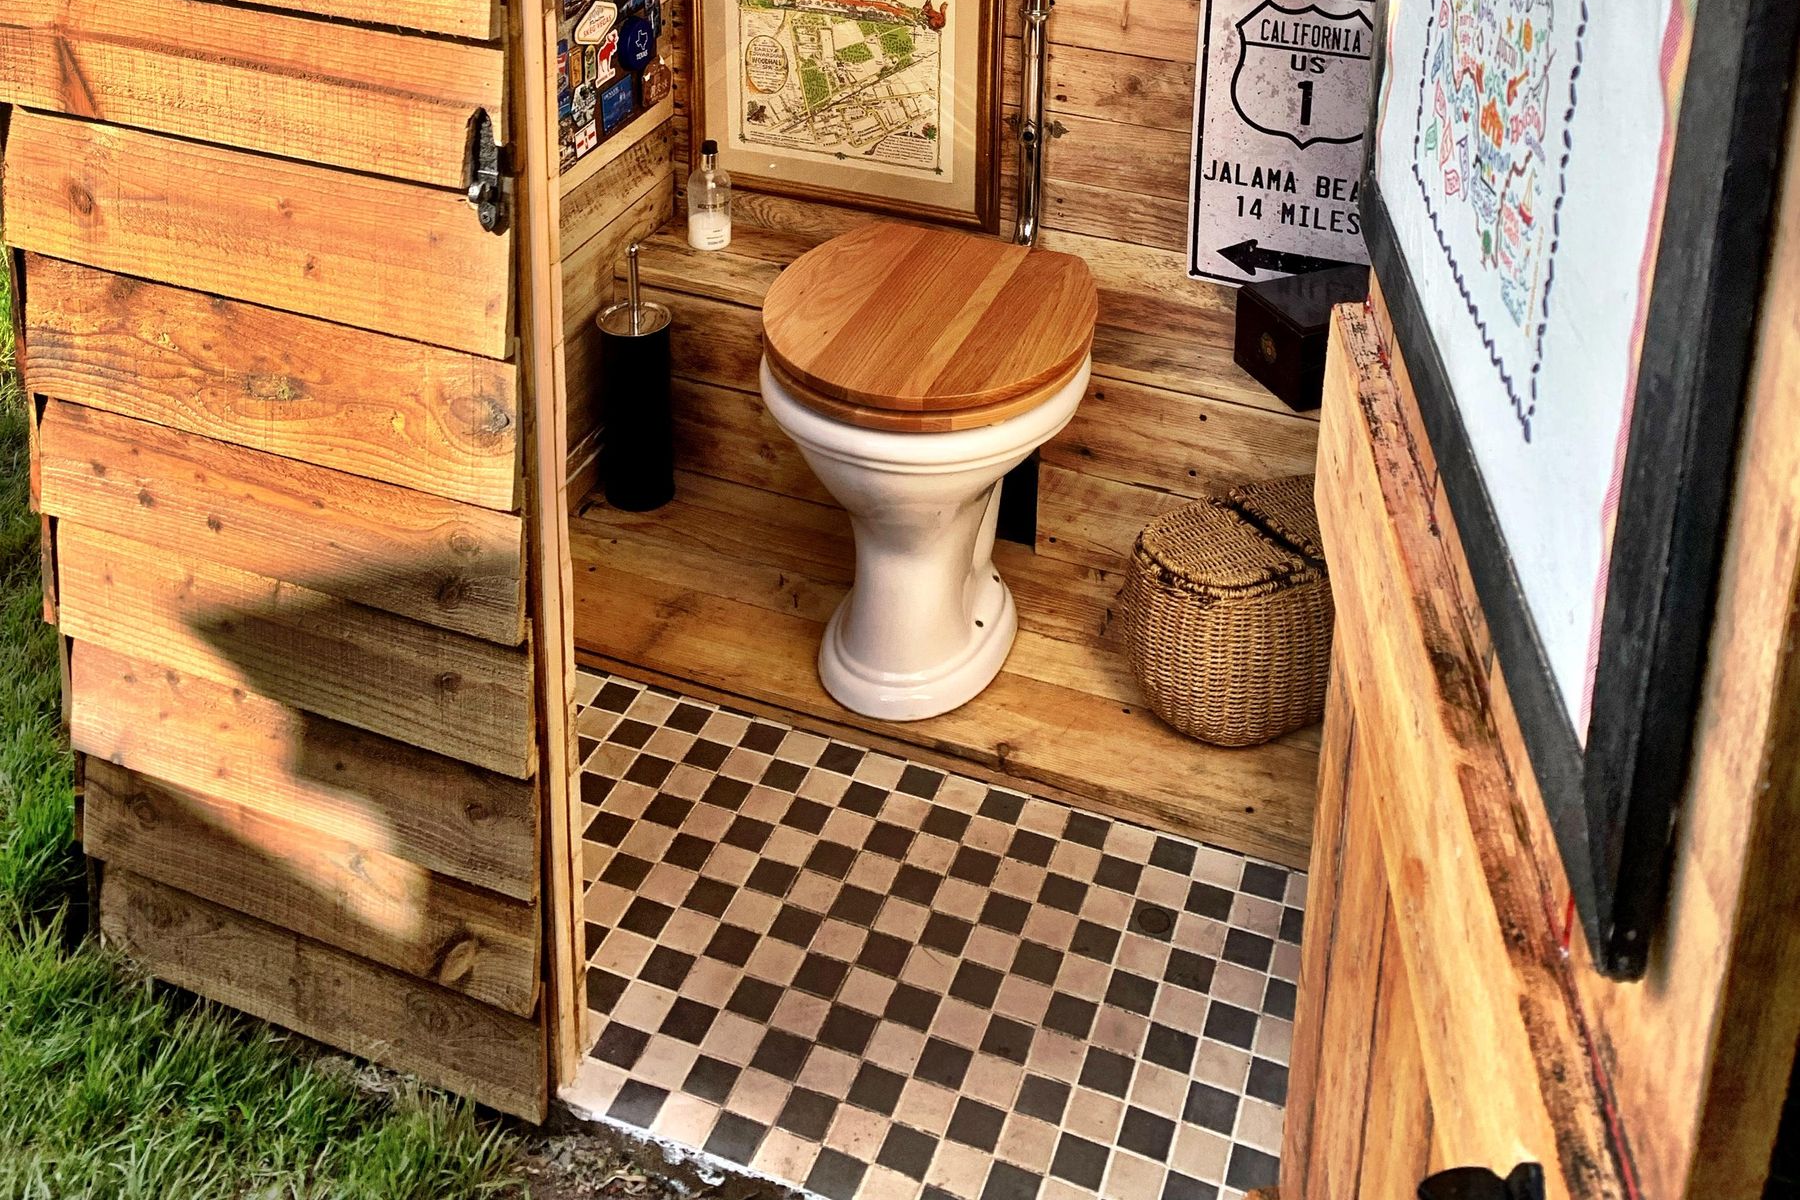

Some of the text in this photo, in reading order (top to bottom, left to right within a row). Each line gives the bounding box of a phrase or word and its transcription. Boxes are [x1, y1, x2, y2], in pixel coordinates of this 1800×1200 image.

[1260, 18, 1361, 53] CALIFORNIA
[636, 49, 648, 60] TEXAS
[1291, 54, 1326, 74] US
[1297, 80, 1314, 126] 1
[1203, 160, 1297, 194] JALAMA
[1236, 195, 1360, 235] 14 MILES
